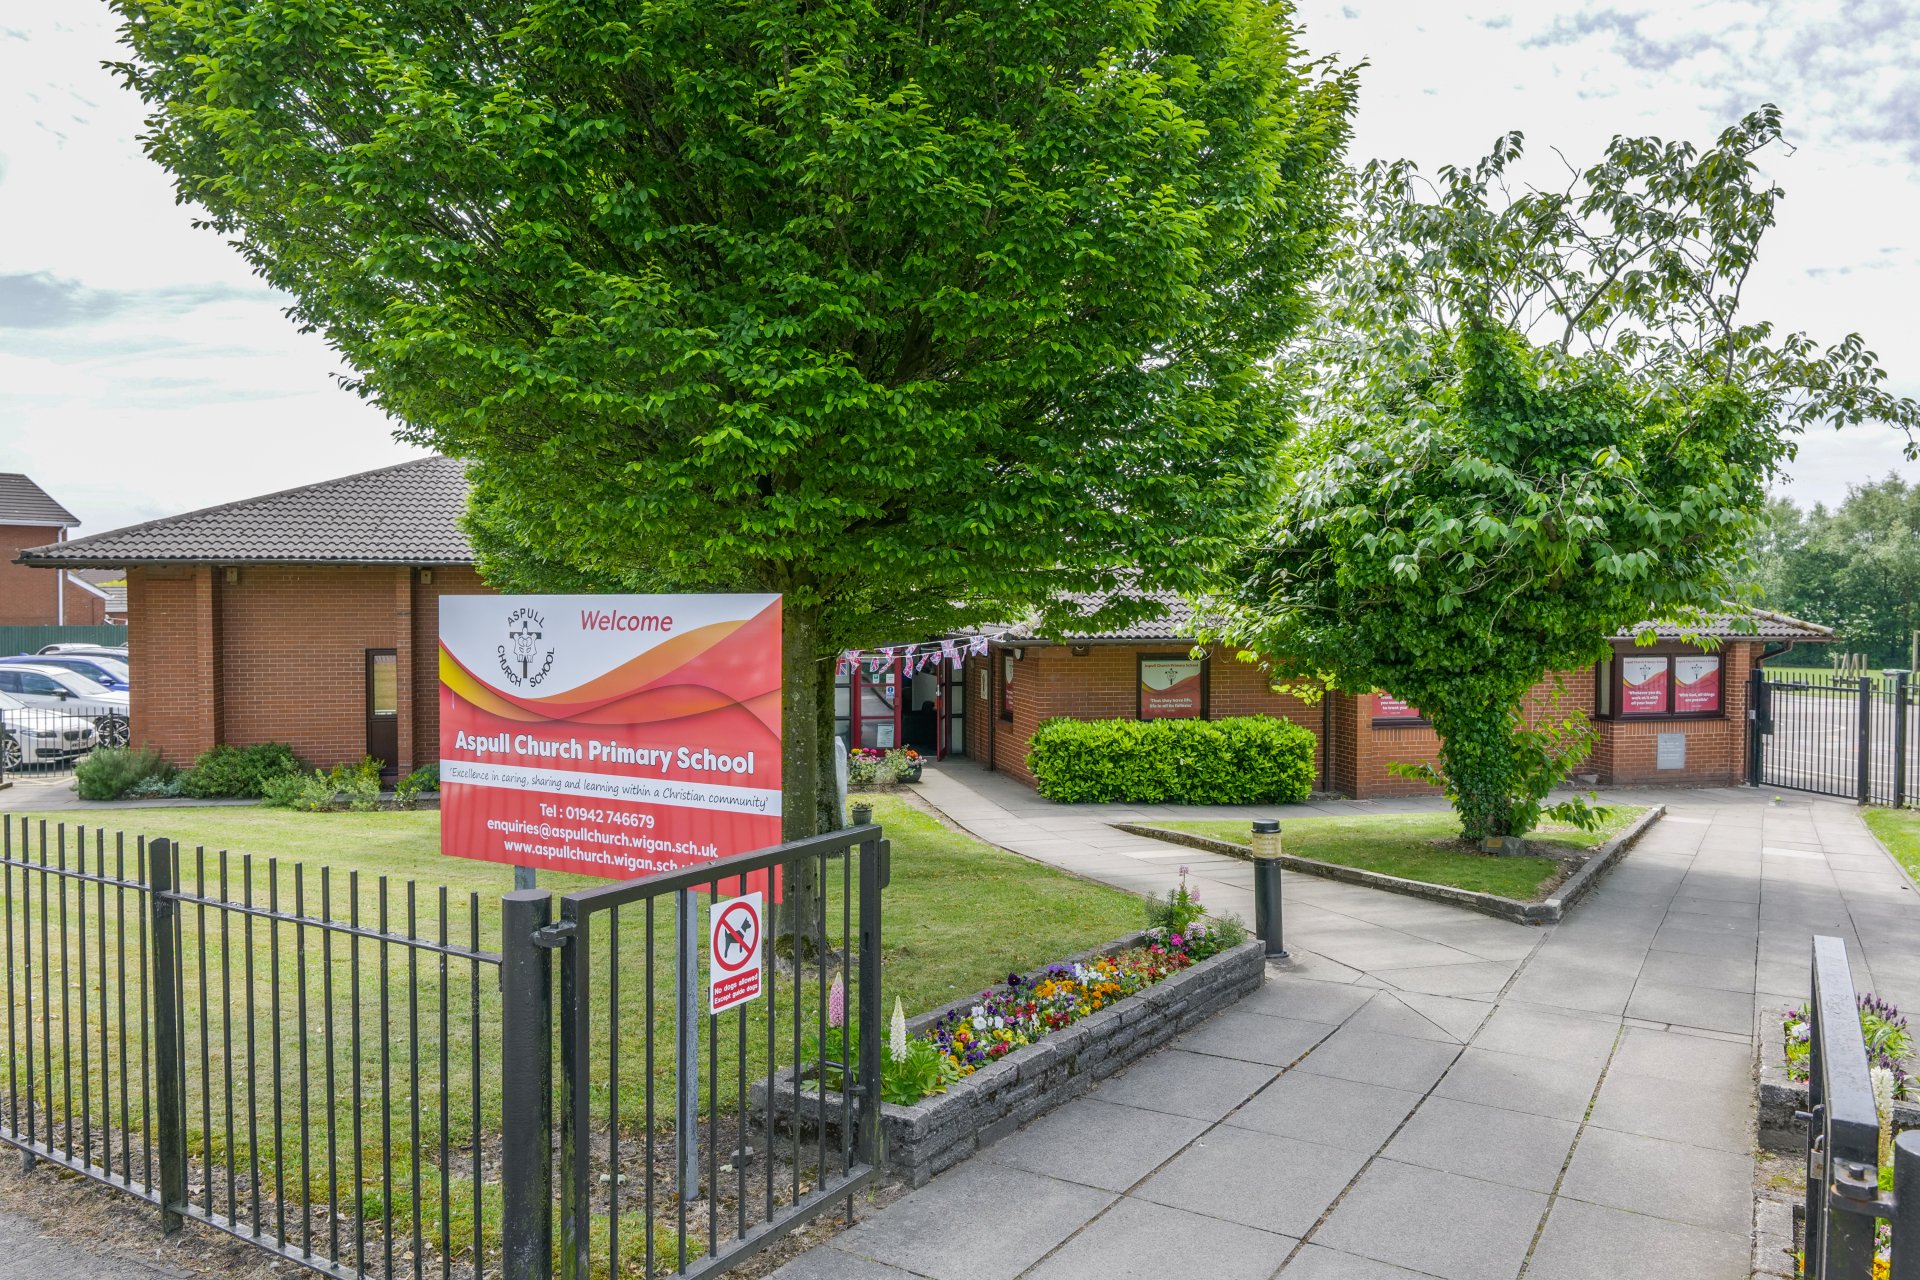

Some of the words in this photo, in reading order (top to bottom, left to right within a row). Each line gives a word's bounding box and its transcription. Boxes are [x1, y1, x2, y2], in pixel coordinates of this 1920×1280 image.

[507, 608, 545, 628] ASPULL
[581, 609, 673, 632] Welcome
[497, 645, 522, 687] CHURCH
[529, 648, 555, 687] SCHOOL
[455, 730, 510, 757] Aspull
[514, 734, 583, 760] Church
[588, 740, 673, 773] Primary
[676, 746, 754, 775] School
[491, 770, 499, 781] in
[501, 772, 529, 787] caring,
[531, 775, 561, 791] sharing
[564, 779, 580, 790] and
[583, 779, 619, 797] learning
[622, 783, 650, 797] within
[653, 789, 660, 797] a
[663, 788, 705, 802] Christian
[539, 803, 556, 818] Tel
[565, 806, 604, 823] 01942
[606, 811, 654, 828] 746679
[487, 819, 719, 858] enquiries@aspullchurch.wigan.sch.uk
[714, 987, 722, 995] No
[723, 982, 737, 992] dogs
[738, 973, 758, 986] allowed
